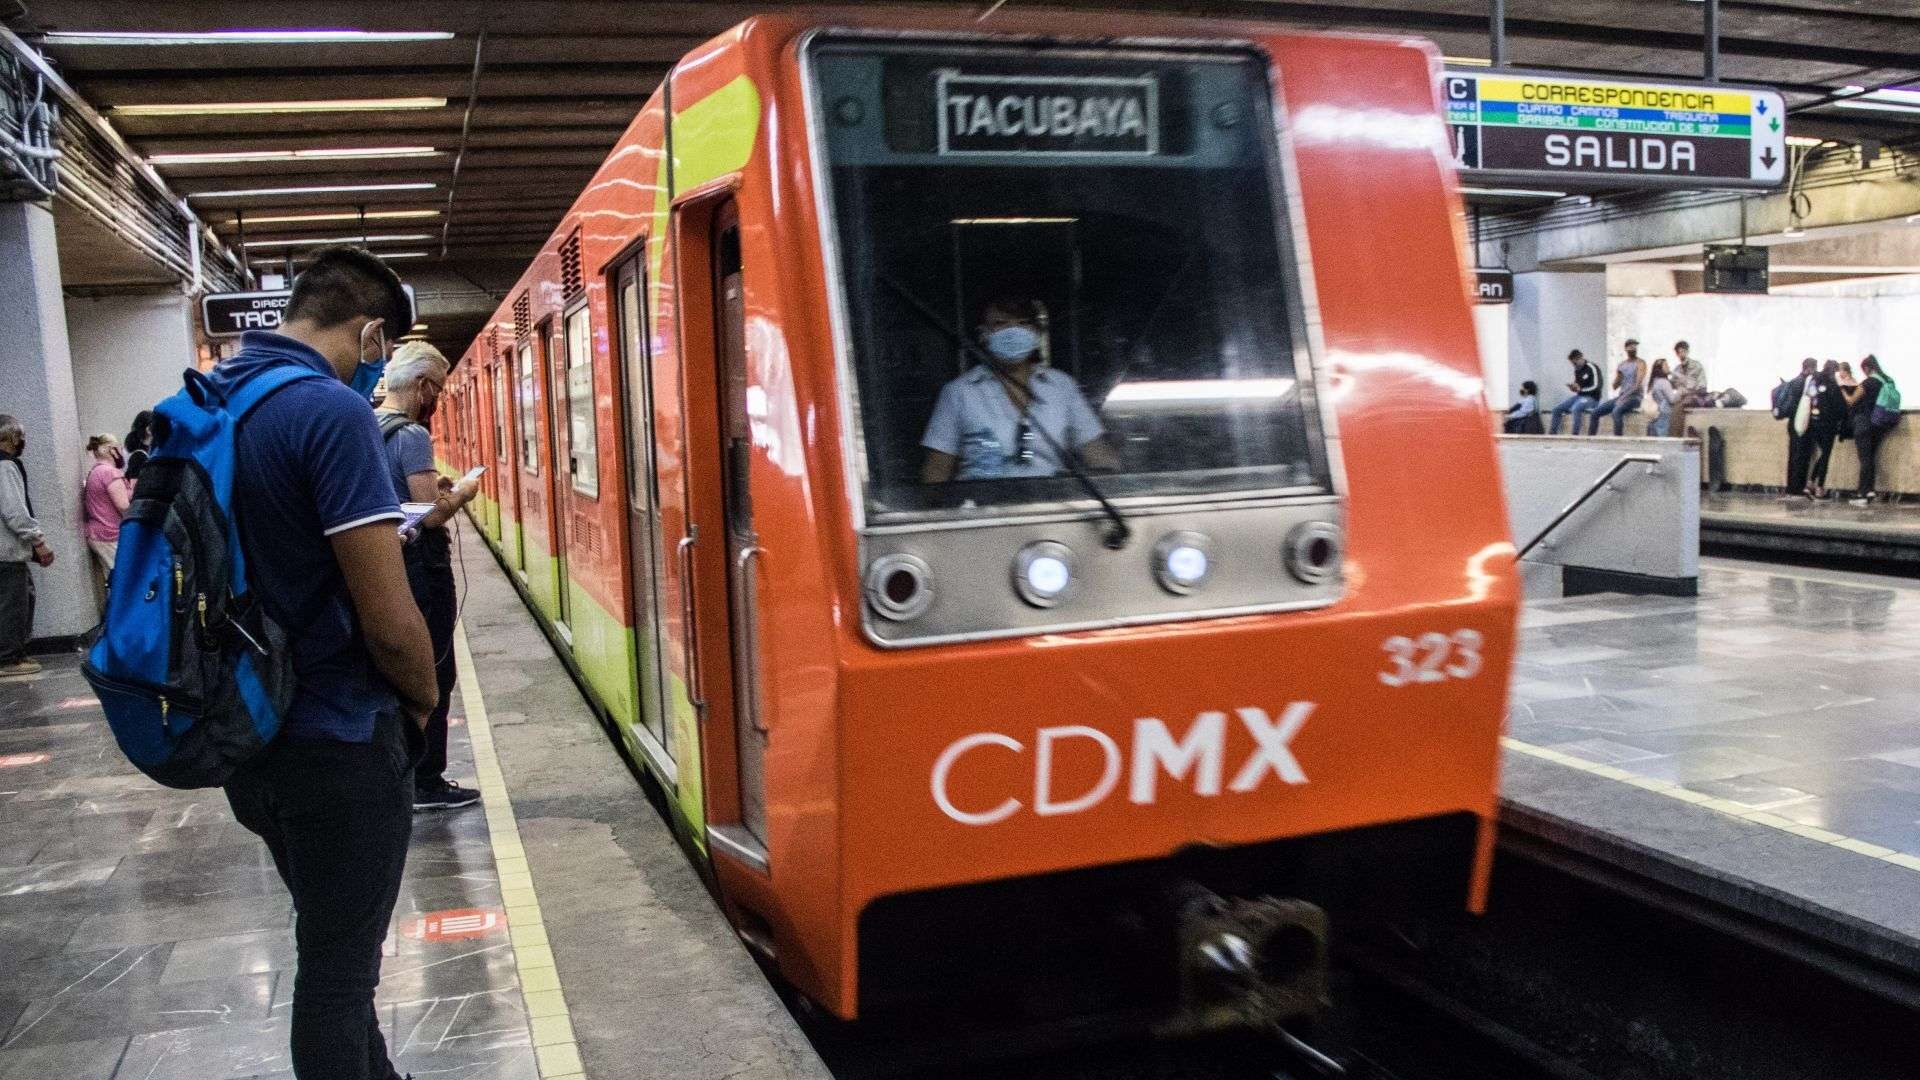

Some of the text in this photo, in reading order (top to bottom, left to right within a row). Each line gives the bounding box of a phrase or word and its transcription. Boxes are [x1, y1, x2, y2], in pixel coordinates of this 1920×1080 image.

[1517, 102, 1563, 115] CUATRO
[1570, 105, 1619, 118] CAMINOS
[1522, 83, 1713, 109] CORRESPONDENCIA
[948, 95, 1146, 137] TACUBAYA
[1517, 114, 1579, 127] GARIBALDI
[1678, 121, 1695, 133] DE
[1545, 134, 1696, 171] SALIDA
[1379, 628, 1483, 688] 323
[930, 701, 1318, 825] CDMX
